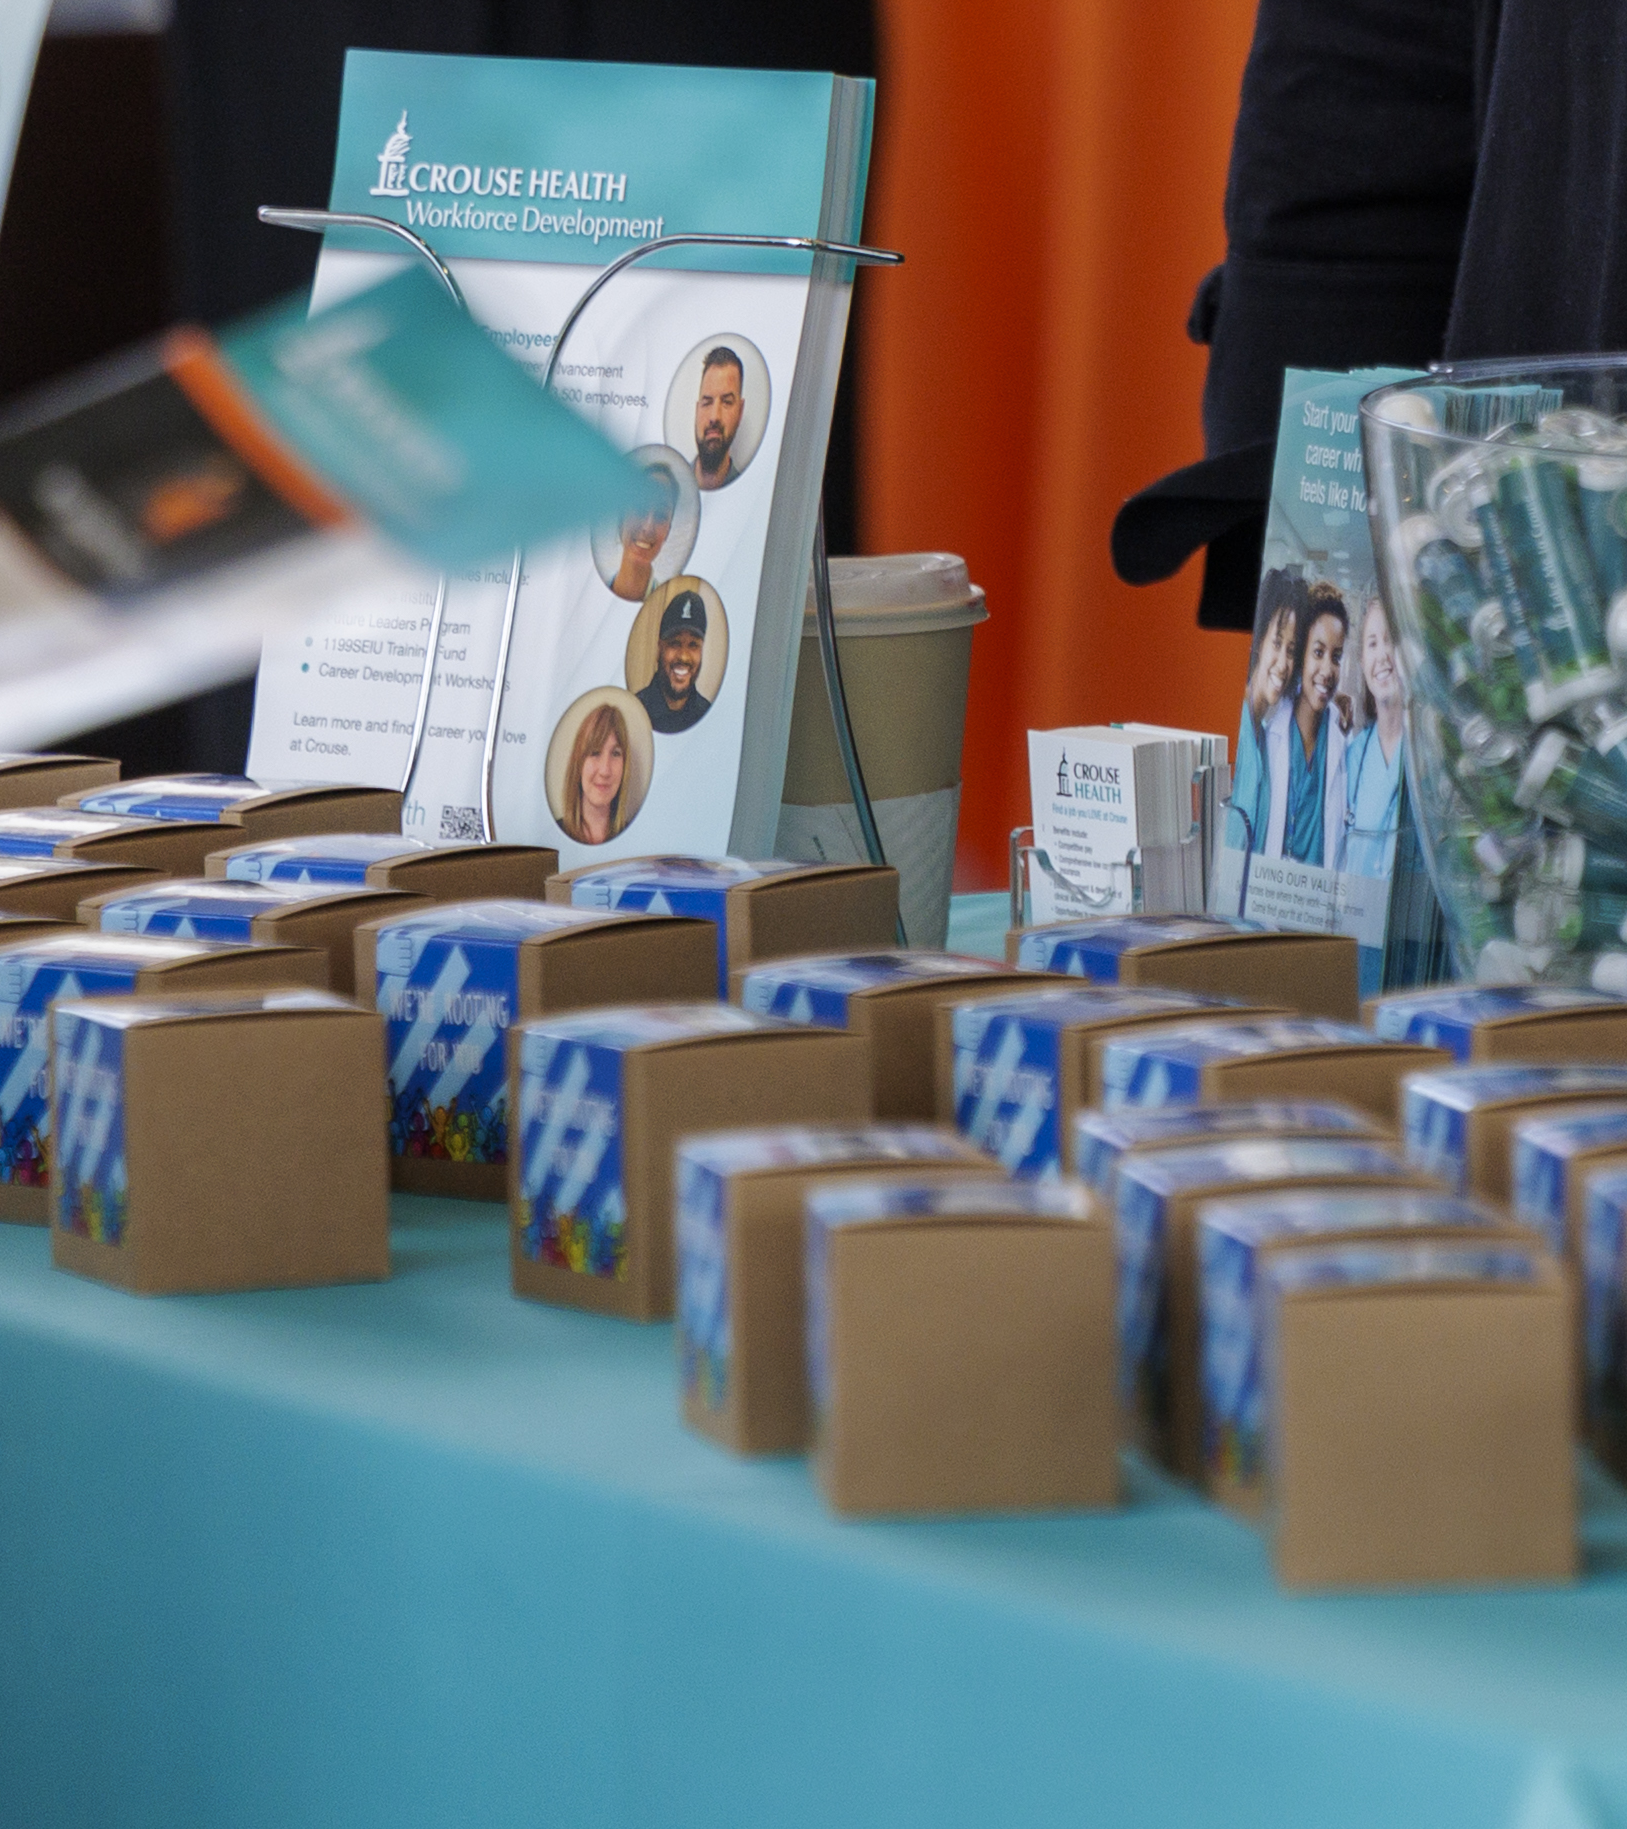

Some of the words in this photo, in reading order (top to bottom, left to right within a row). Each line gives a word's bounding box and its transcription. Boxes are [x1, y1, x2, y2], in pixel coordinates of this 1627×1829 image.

[409, 163, 522, 197] CROUSE
[528, 169, 627, 202] HEALTH
[406, 200, 517, 231] Workforce
[522, 206, 664, 245] Development
[556, 362, 624, 378] vancement
[585, 392, 649, 409] employees,
[1303, 400, 1329, 430] Start
[1329, 412, 1359, 436] your
[1305, 445, 1341, 469] career
[1300, 476, 1326, 505] feels
[1327, 481, 1349, 509] like
[484, 569, 529, 586] inclue:
[369, 613, 417, 631] Leaders
[420, 618, 471, 637] Prgram
[323, 637, 383, 655] 1199SEIU
[387, 641, 428, 658] Trainin
[318, 662, 359, 680] Career
[362, 666, 441, 687] Developmt
[445, 673, 511, 692] Workshos
[293, 712, 328, 729] Learn
[330, 716, 362, 732] more
[365, 719, 388, 735] and
[428, 724, 465, 740] career
[503, 729, 527, 745] love
[289, 738, 302, 752] at
[305, 739, 351, 757] Crouse.
[1073, 762, 1120, 785] CROUSE
[1074, 782, 1122, 805] HEALTH
[405, 800, 426, 826] th
[1254, 866, 1283, 884] LIVING
[1286, 872, 1307, 888] OUR
[444, 992, 510, 1029] ROOTING
[29, 1069, 52, 1100] FO
